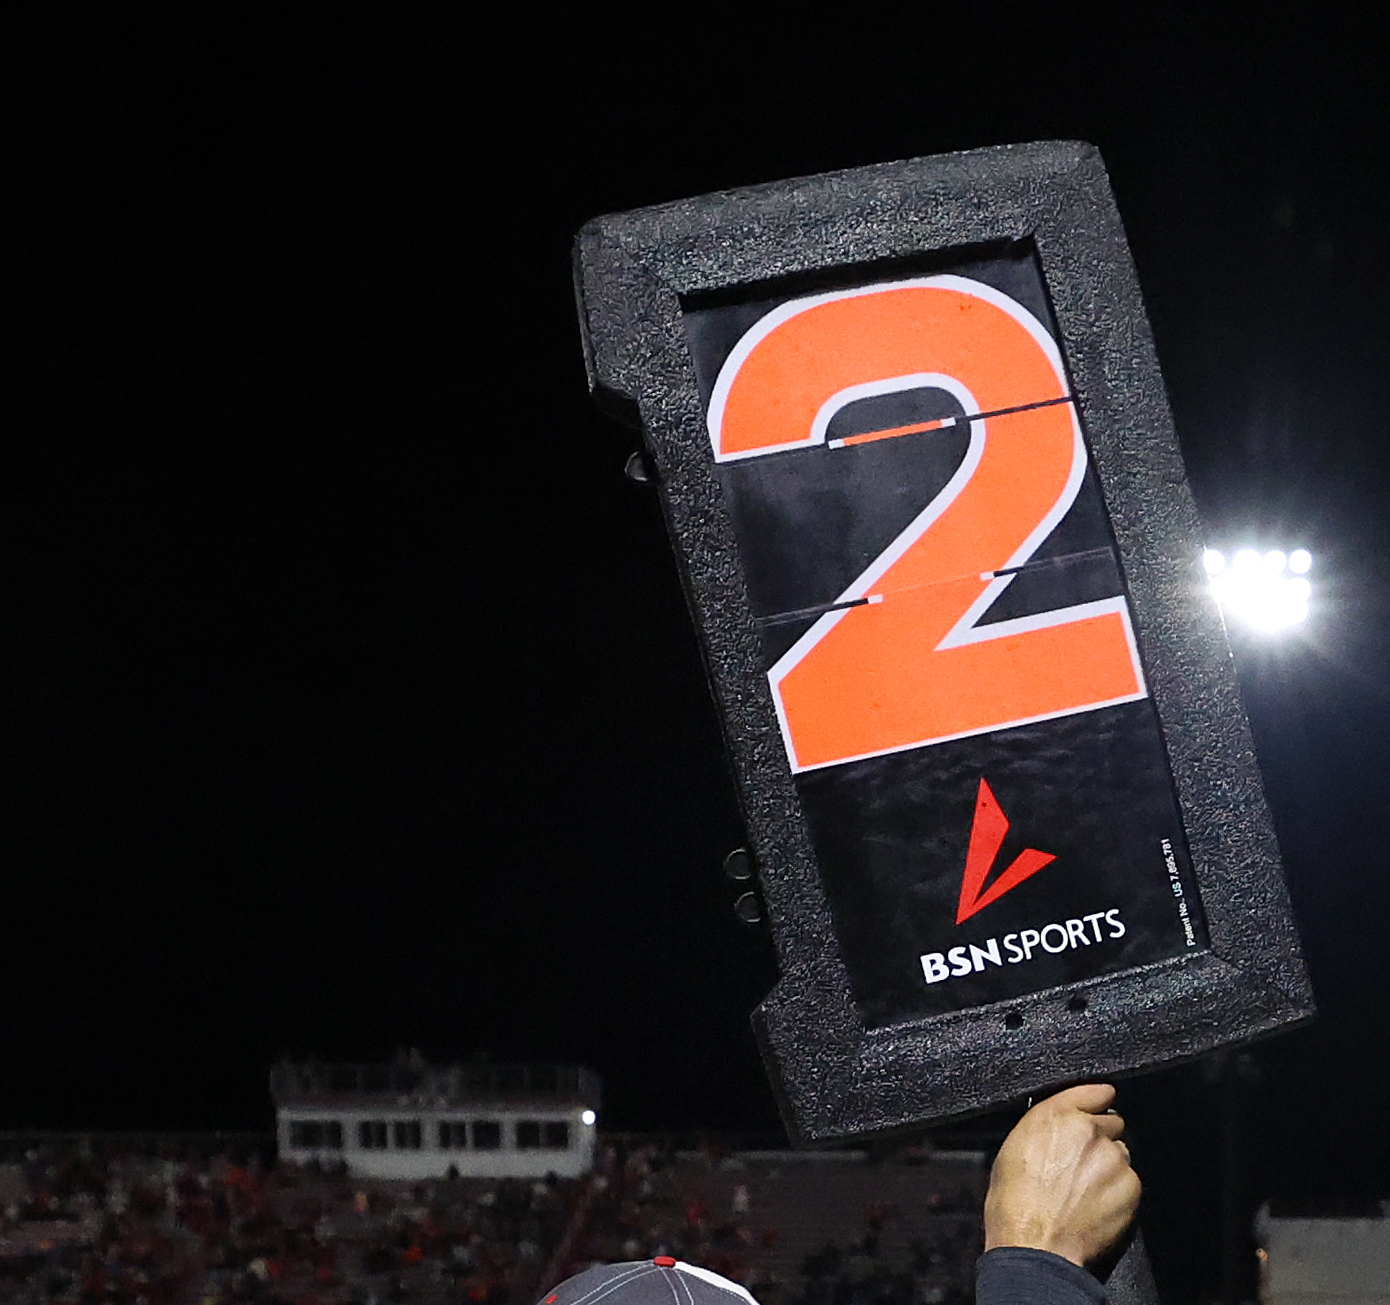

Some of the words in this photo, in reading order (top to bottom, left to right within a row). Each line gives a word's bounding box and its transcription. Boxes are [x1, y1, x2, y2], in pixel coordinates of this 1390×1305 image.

[708, 274, 1147, 775] 2
[1172, 883, 1183, 897] US
[919, 938, 1003, 985] BSN
[1003, 908, 1127, 964] SPORTS
[1182, 917, 1197, 947] Patent
